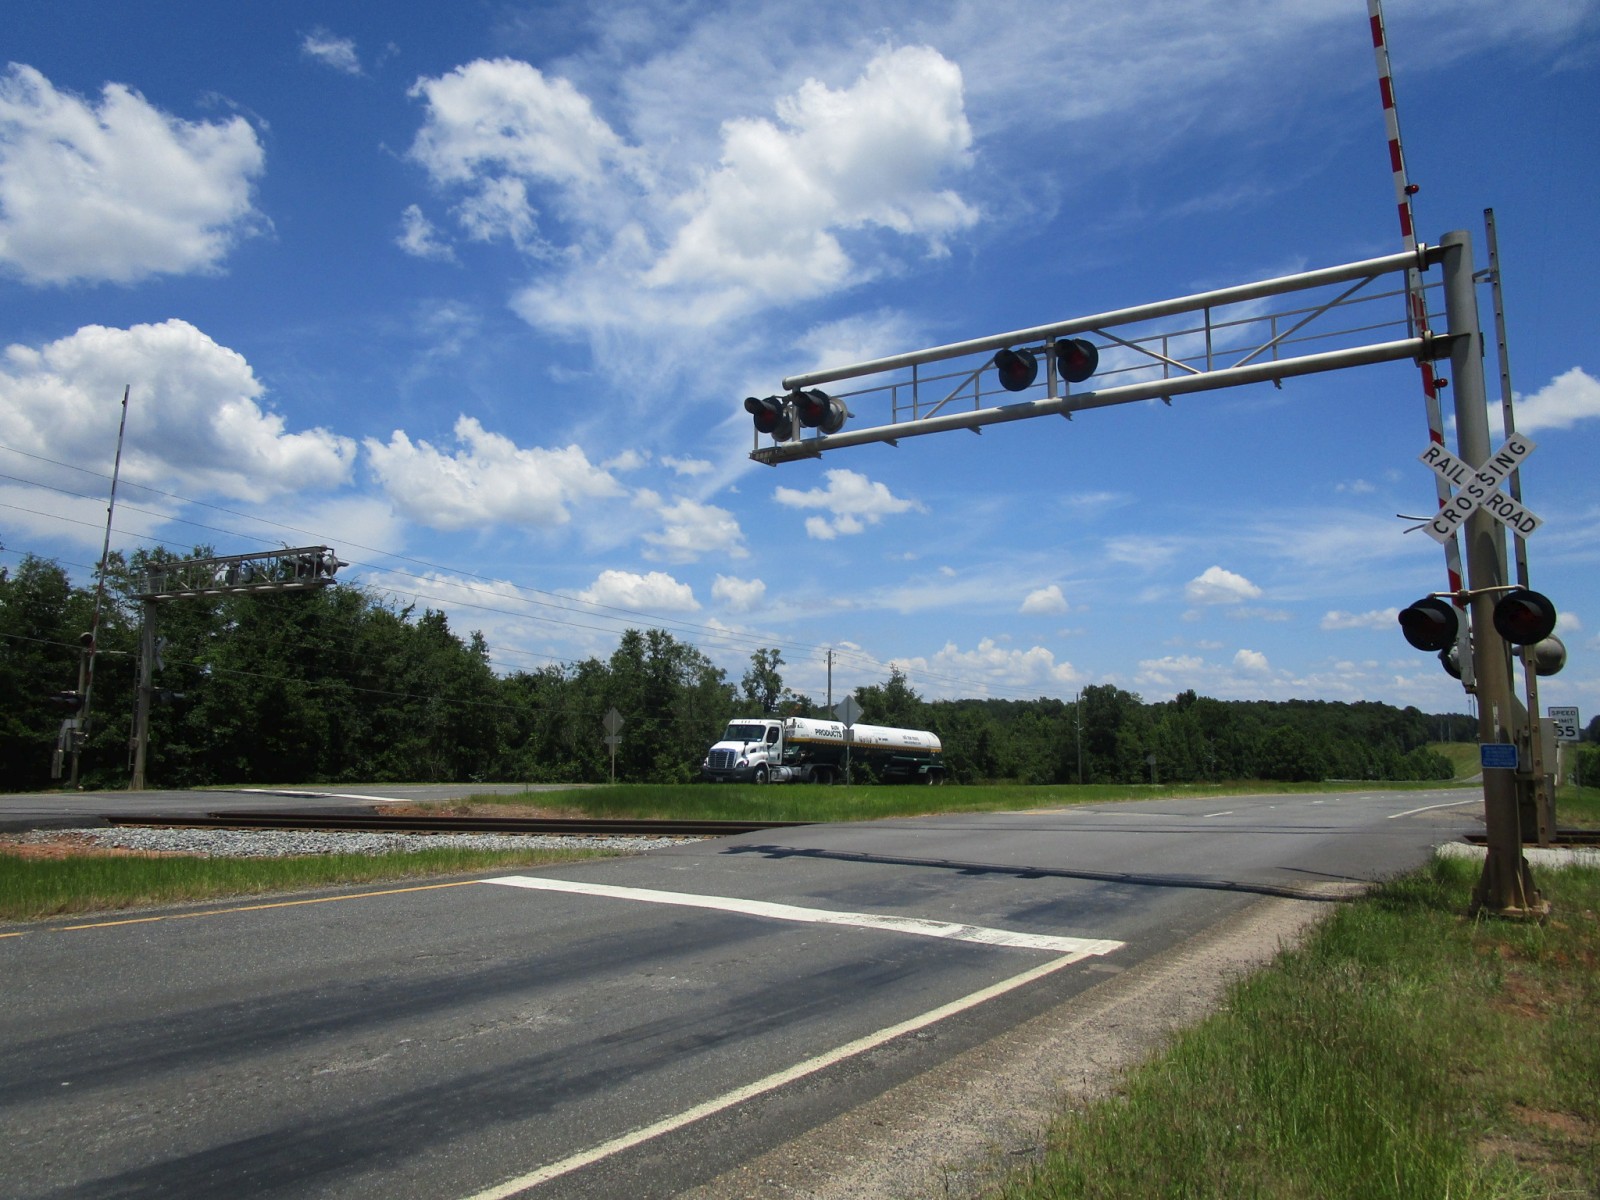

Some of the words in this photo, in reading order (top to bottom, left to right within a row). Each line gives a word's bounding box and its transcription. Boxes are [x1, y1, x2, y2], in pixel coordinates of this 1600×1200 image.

[1423, 446, 1465, 485] RAIL
[1486, 493, 1536, 533] ROAD
[1433, 441, 1526, 534] CROSSING
[814, 728, 842, 738] PRODUCTS
